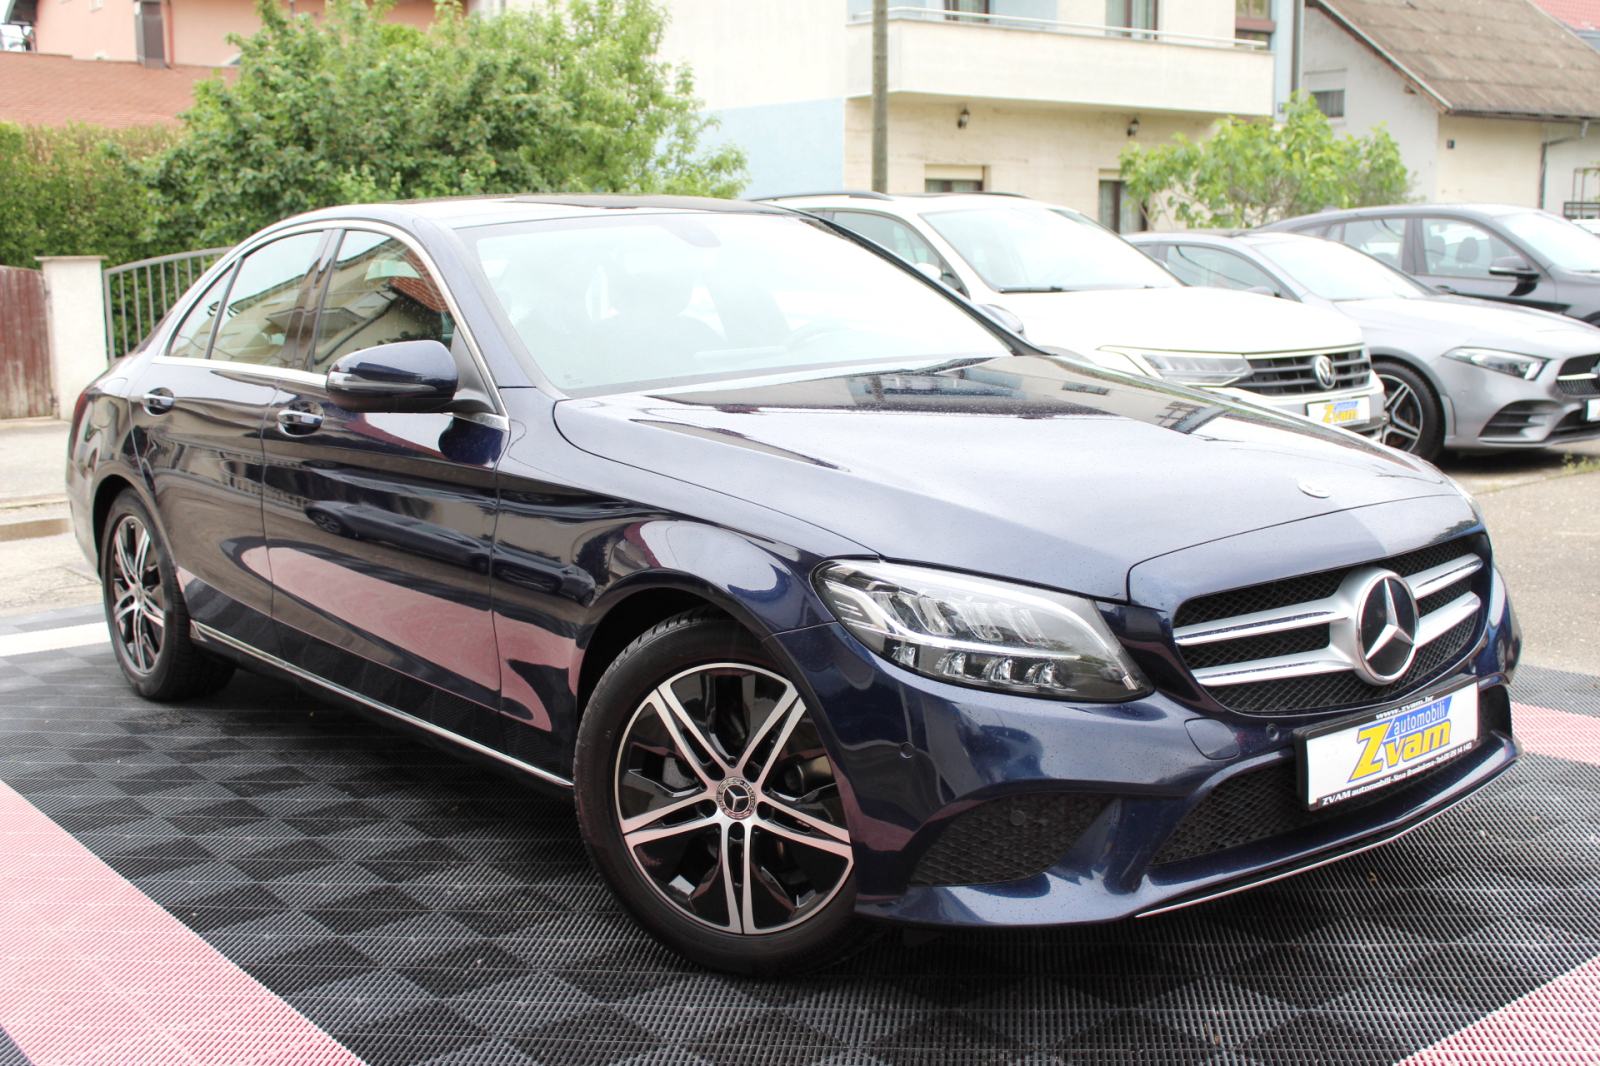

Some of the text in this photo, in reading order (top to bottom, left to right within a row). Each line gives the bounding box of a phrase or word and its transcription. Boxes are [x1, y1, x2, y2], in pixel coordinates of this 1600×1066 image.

[1393, 700, 1446, 736] automobili
[1347, 718, 1452, 783] Zvam
[1322, 789, 1351, 806] ZVAM
